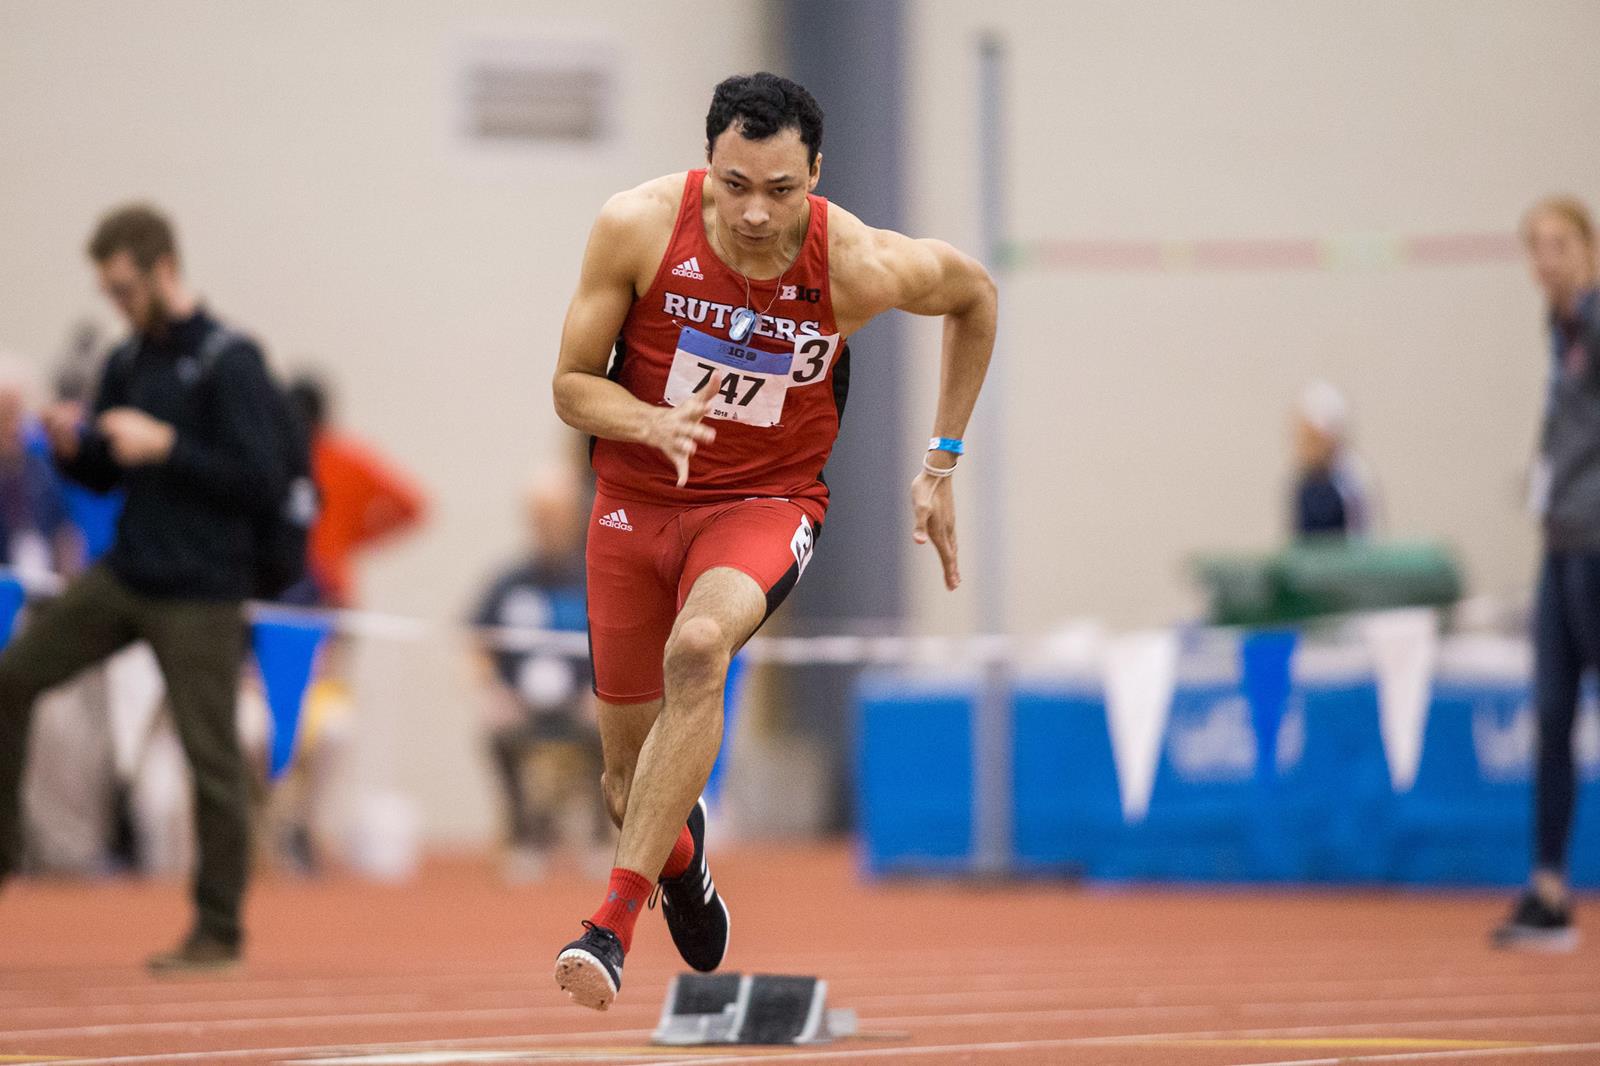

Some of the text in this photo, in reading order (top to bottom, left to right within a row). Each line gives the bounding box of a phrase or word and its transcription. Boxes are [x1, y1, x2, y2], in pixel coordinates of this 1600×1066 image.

[671, 268, 704, 281] adidas
[792, 339, 830, 383] 3
[692, 362, 766, 407] 747
[713, 409, 728, 418] 2018
[598, 518, 633, 532] adidas
